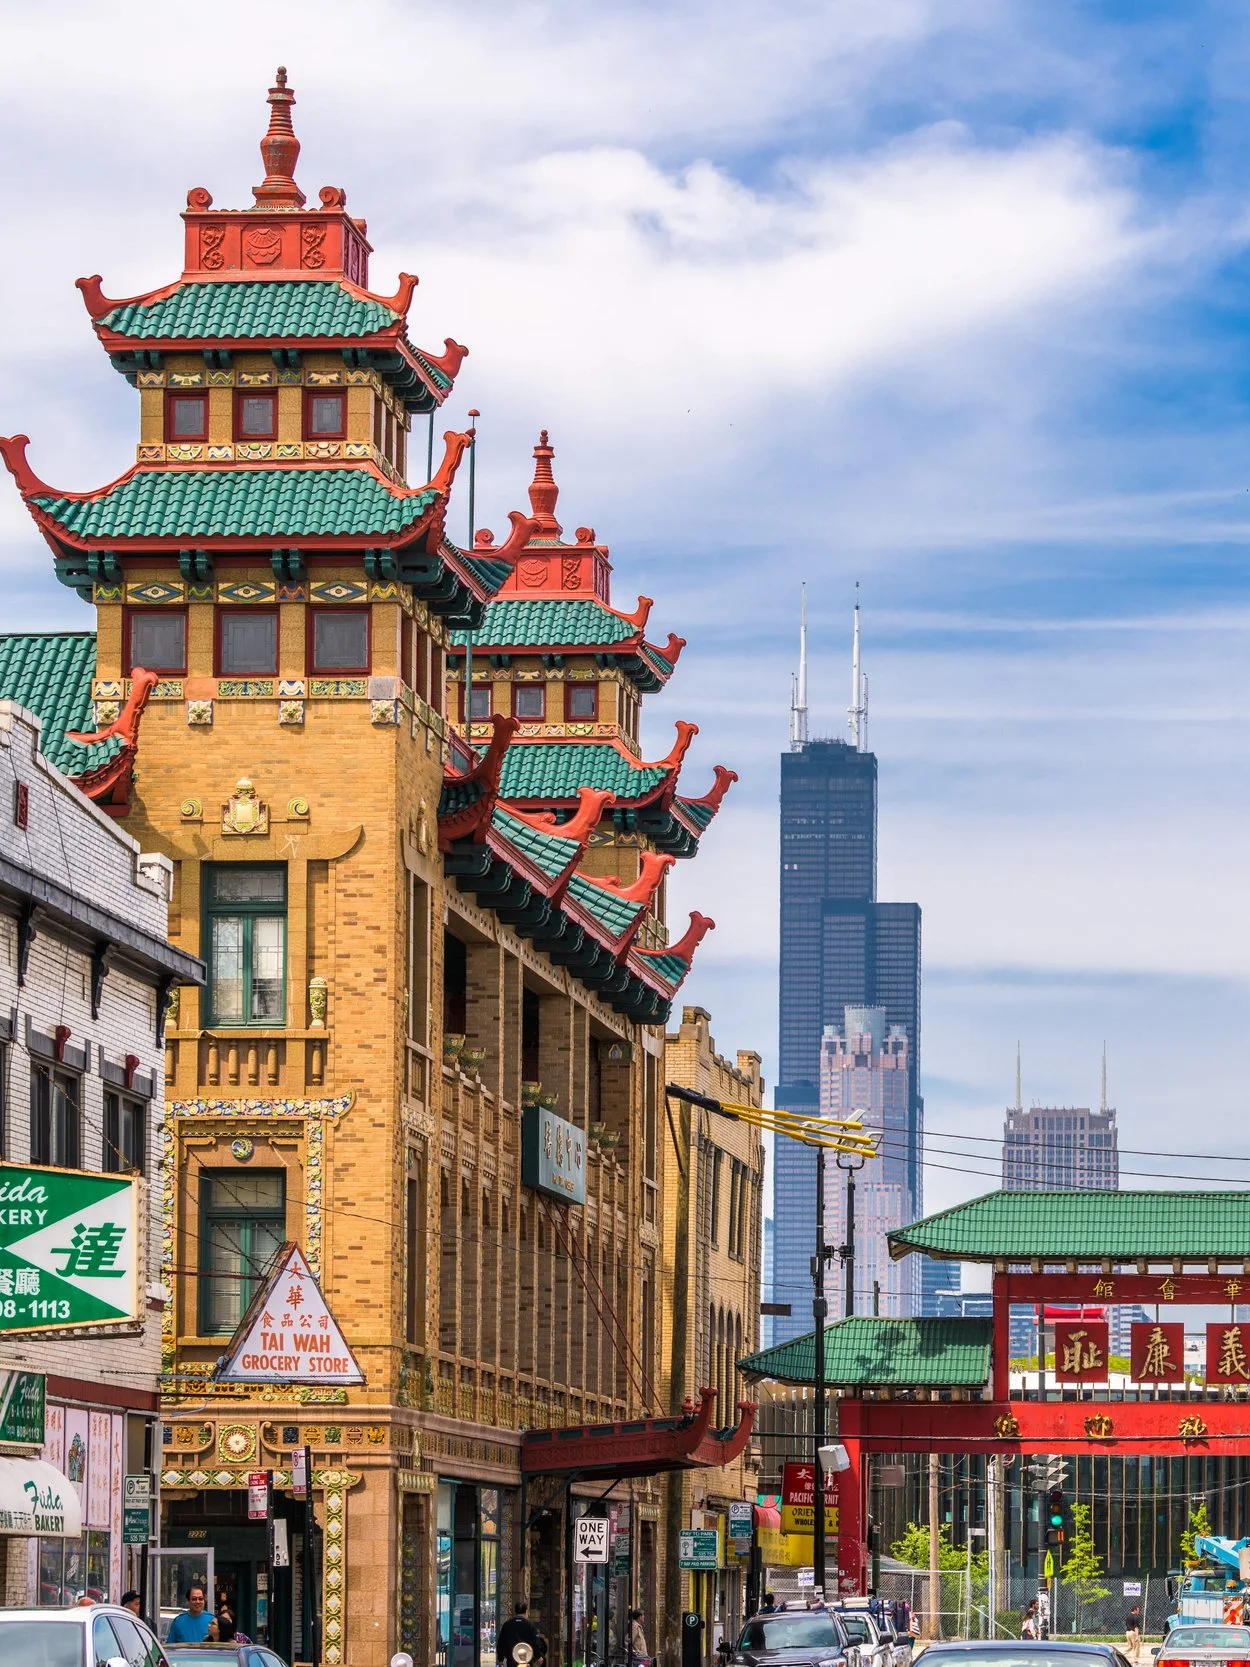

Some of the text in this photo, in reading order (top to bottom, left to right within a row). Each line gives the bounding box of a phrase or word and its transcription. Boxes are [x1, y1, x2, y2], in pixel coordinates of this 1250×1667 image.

[0, 1176, 49, 1204] ida
[50, 1222, 127, 1279] 達
[0, 1300, 71, 1319] 8-1113
[260, 1311, 329, 1330] 食品公司
[261, 1333, 330, 1353] TAI WAH
[242, 1354, 349, 1373] GROCERY STORE
[789, 1492, 814, 1504] PACIFIC
[791, 1508, 832, 1518] ORIENAL
[34, 1514, 65, 1532] BAKERY
[579, 1522, 604, 1533] ONE
[579, 1534, 605, 1545] WAY
